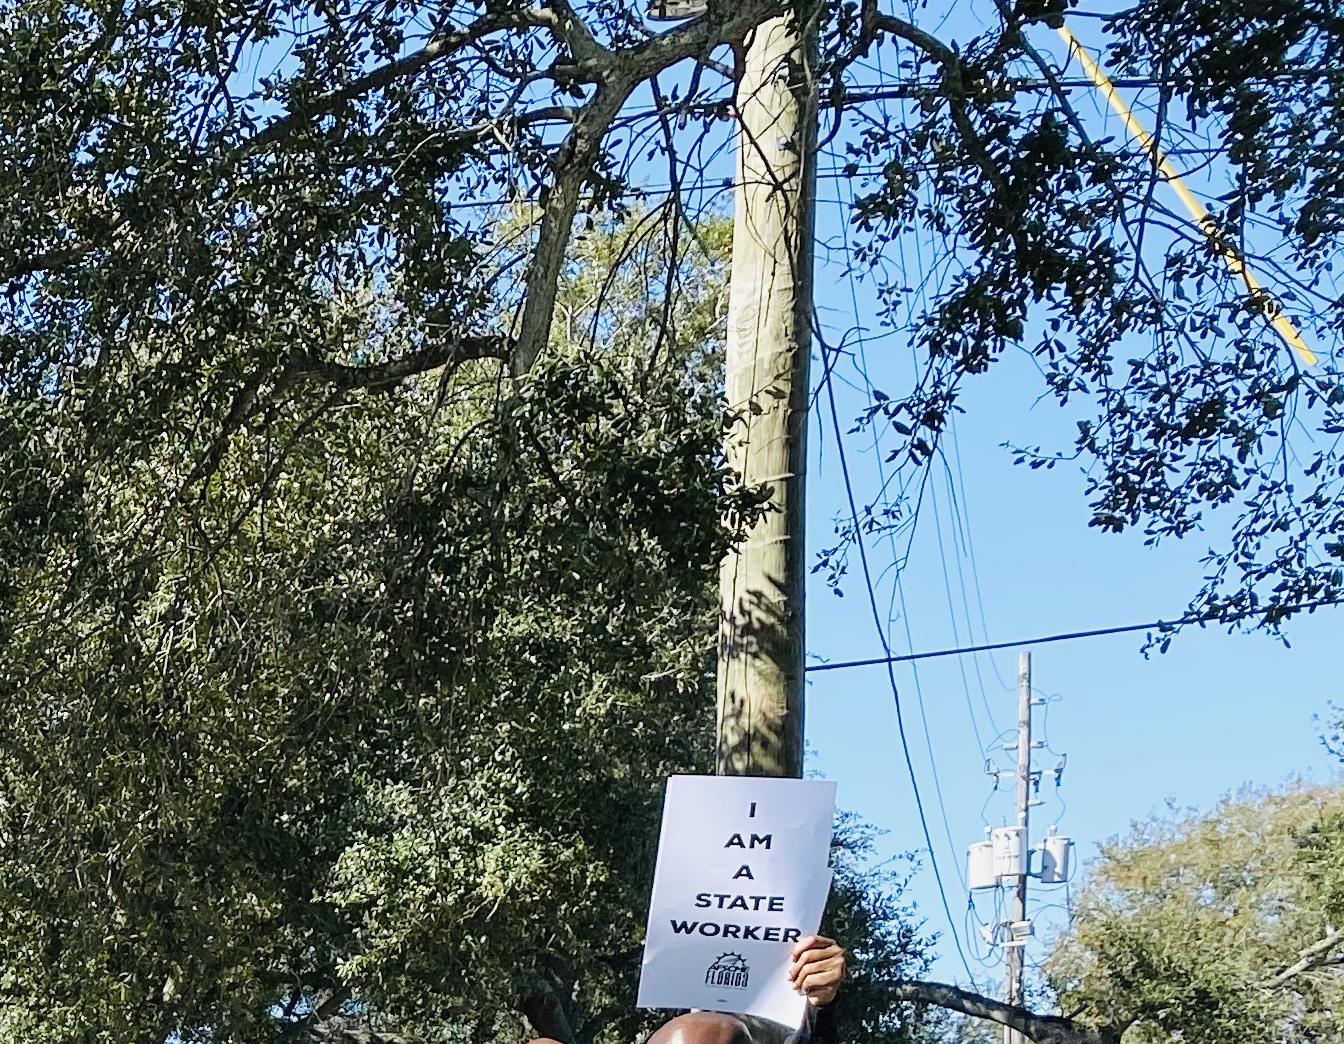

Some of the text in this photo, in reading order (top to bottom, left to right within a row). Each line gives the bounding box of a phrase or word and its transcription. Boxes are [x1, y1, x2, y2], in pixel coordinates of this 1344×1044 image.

[748, 802, 757, 818] I
[724, 833, 773, 850] AM
[732, 864, 755, 880] A
[694, 892, 785, 912] STATE
[669, 919, 802, 944] WORKER
